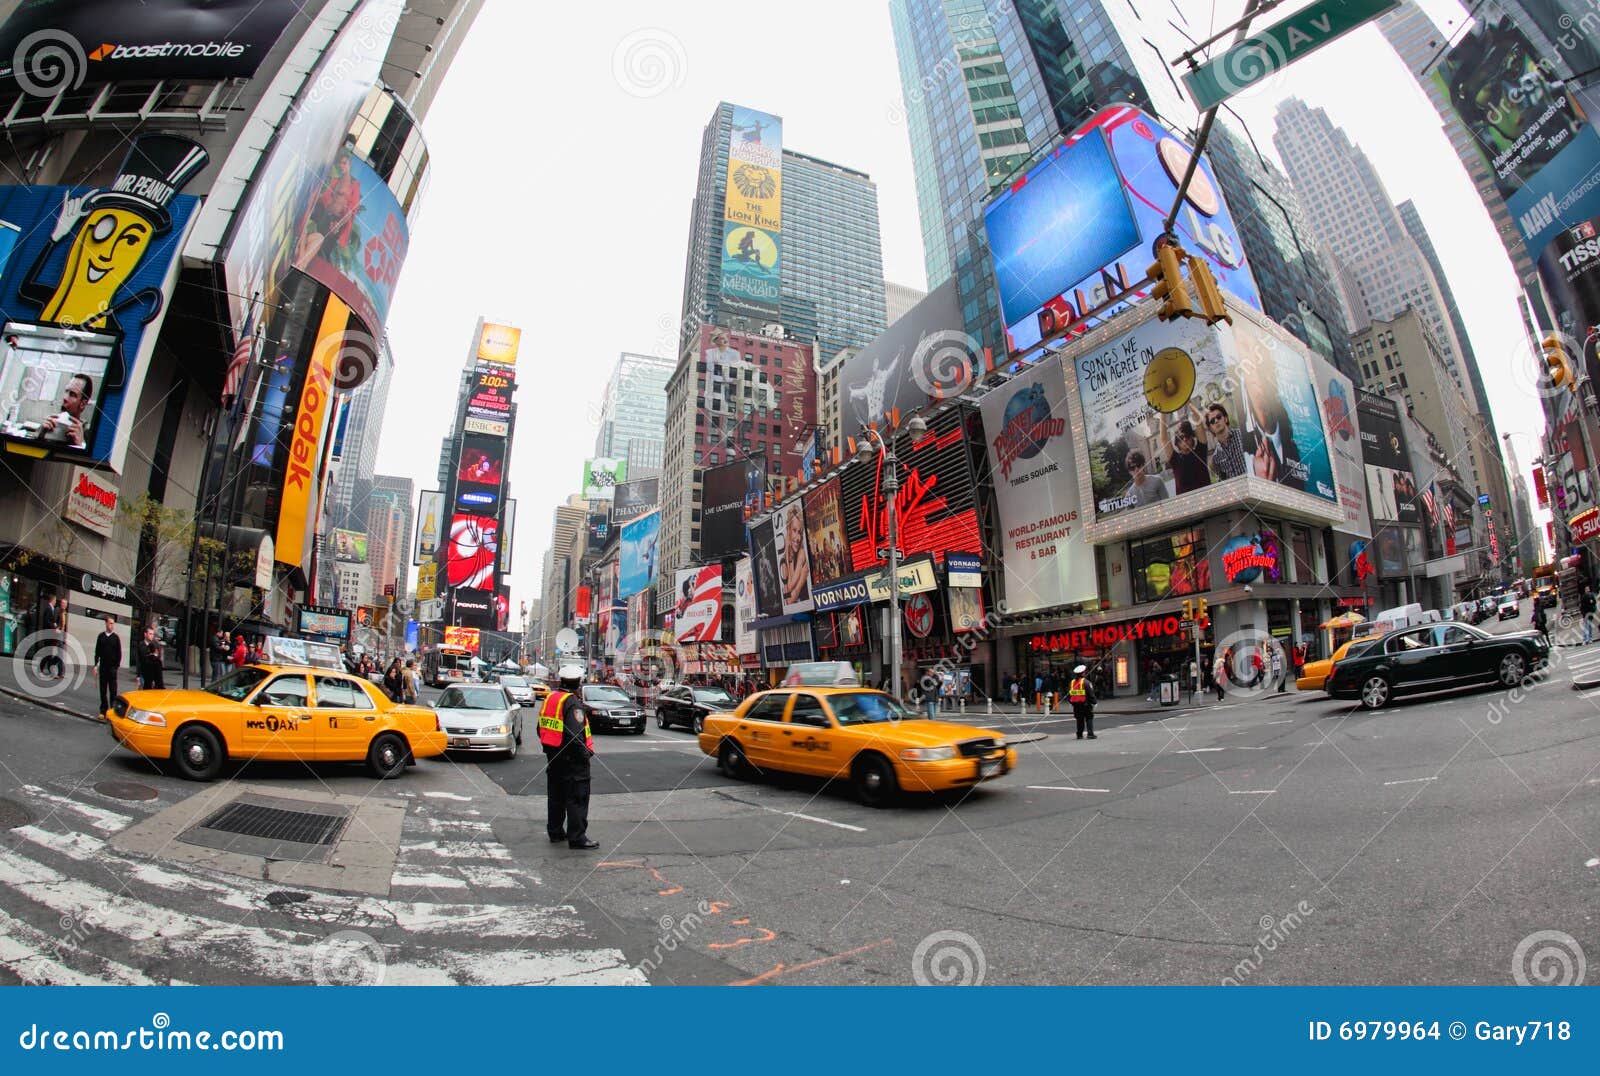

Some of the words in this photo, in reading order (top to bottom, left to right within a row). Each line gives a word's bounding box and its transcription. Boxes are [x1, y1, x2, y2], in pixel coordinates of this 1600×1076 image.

[1492, 148, 1512, 169] Make
[1511, 134, 1527, 152] sure
[1525, 122, 1540, 140] you
[1537, 106, 1555, 127] wash
[1553, 96, 1566, 113] up
[1497, 155, 1521, 179] before
[728, 207, 752, 221] LION
[754, 213, 779, 228] KING
[745, 202, 762, 211] THE
[1559, 236, 1600, 271] TISS
[1082, 348, 1119, 380] SONGS
[1121, 336, 1138, 356] WE
[1090, 371, 1108, 392] CAN
[1110, 354, 1139, 381] AGREE
[1010, 473, 1029, 488] TIMES
[1029, 462, 1059, 480] SQUARE
[1008, 510, 1078, 538] WORLD-FAMOUS
[1015, 526, 1072, 550] RESTAURANT
[1038, 545, 1057, 558] BAR
[813, 582, 867, 606] VORNADO
[1032, 626, 1087, 651] PLANET
[246, 719, 265, 729] NYC
